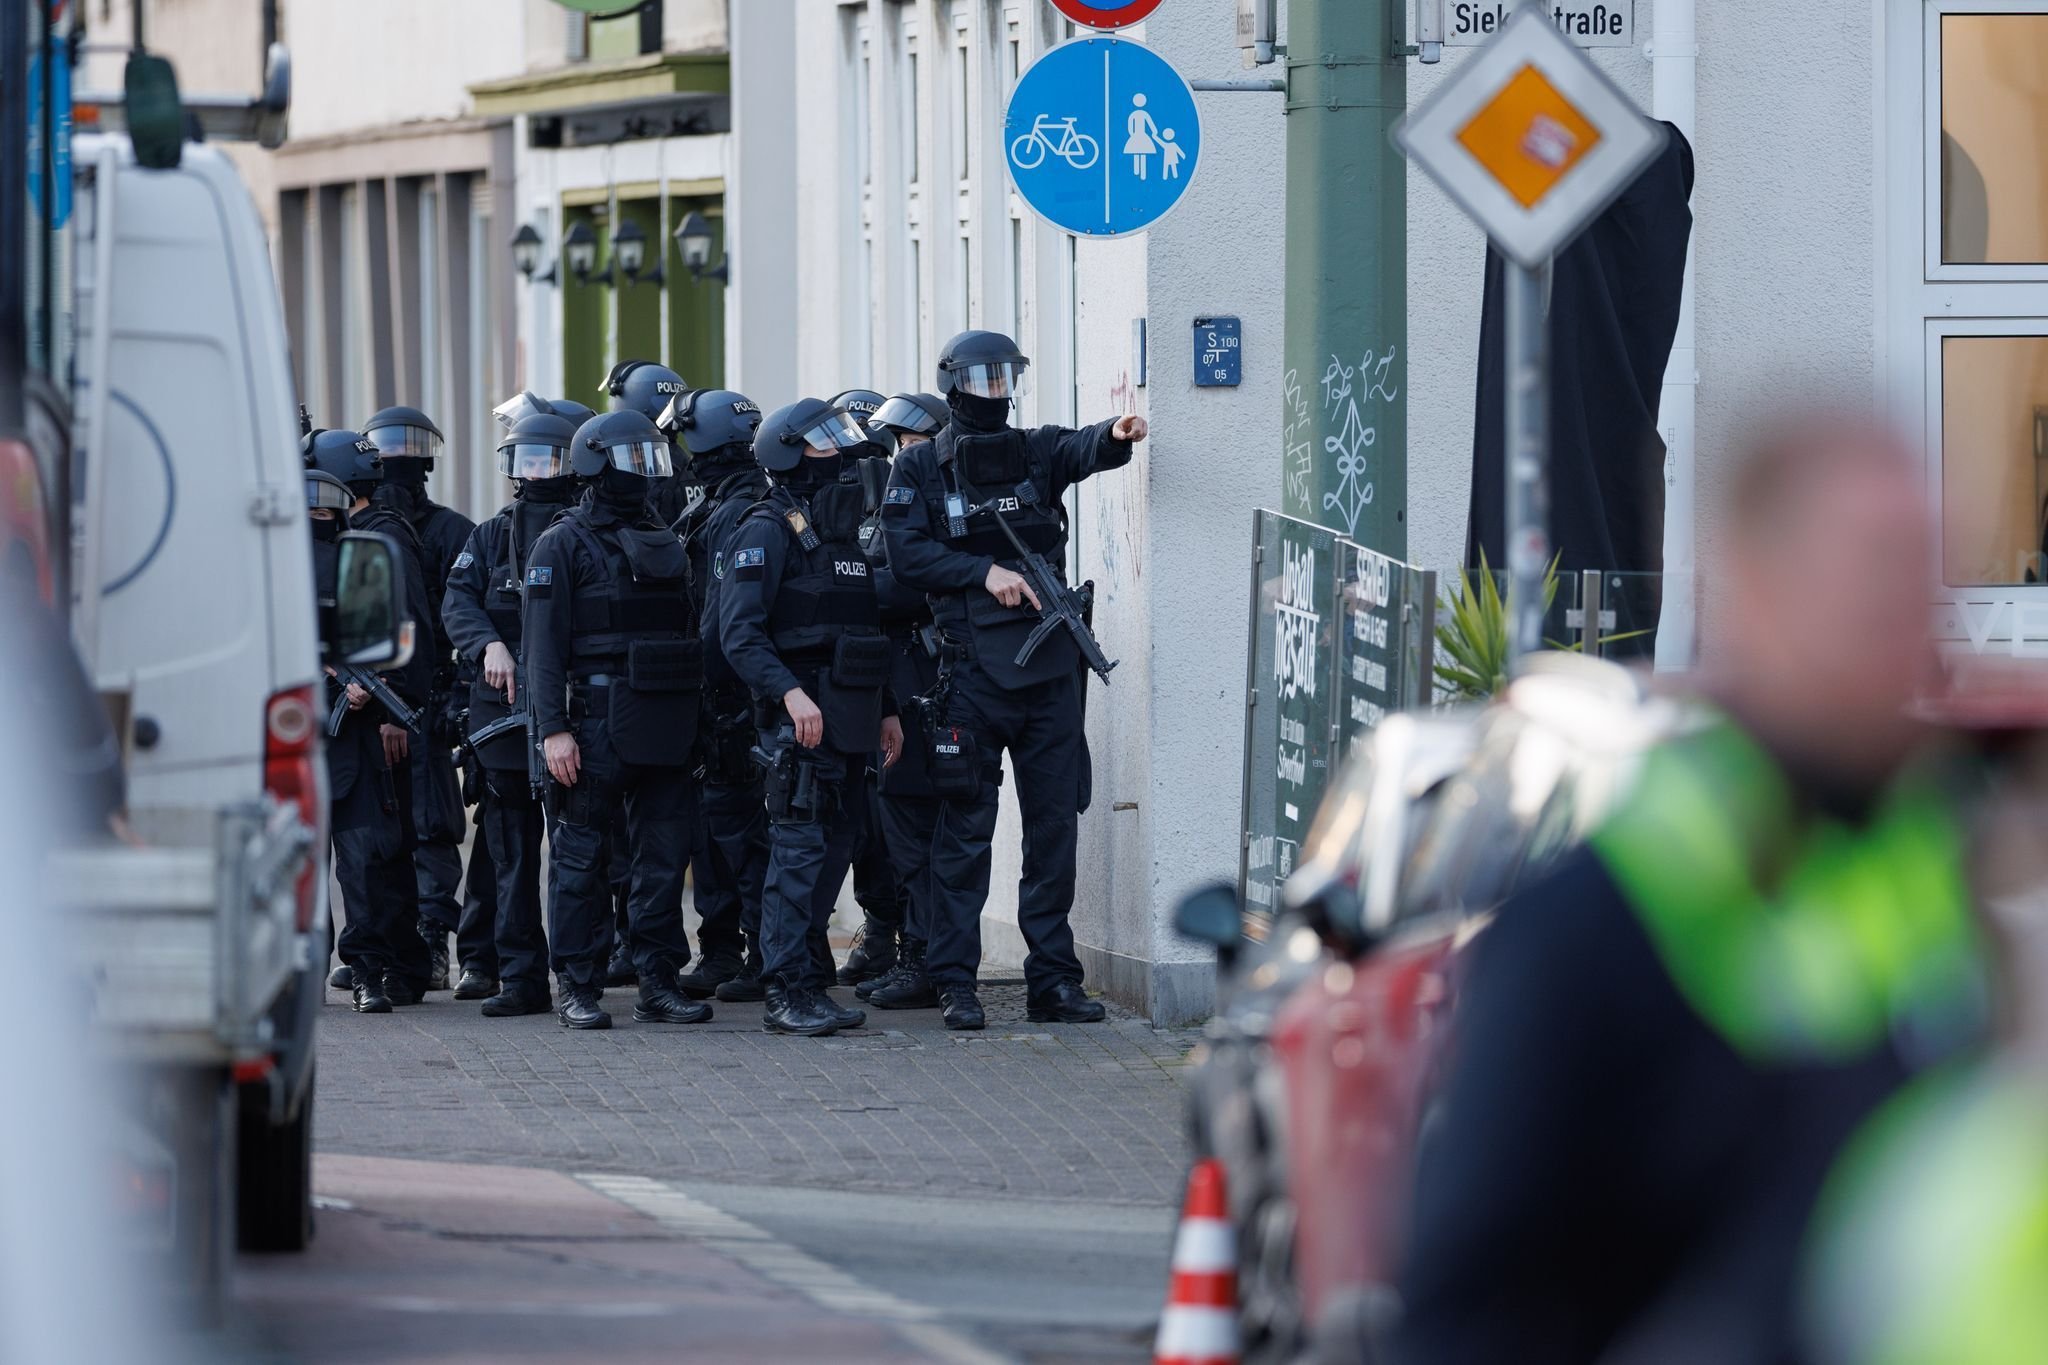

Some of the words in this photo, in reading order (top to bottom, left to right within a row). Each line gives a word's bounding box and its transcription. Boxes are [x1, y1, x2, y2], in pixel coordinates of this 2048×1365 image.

[1456, 3, 1623, 35] Siektraße
[1207, 332, 1217, 348] S
[1220, 337, 1239, 348] 100
[1202, 354, 1215, 365] 07
[1214, 369, 1227, 380] 05
[848, 400, 880, 413] POLIZE
[834, 561, 867, 577] POLIZEI
[1282, 538, 1315, 612] Urban
[936, 744, 960, 754] POLIZEI
